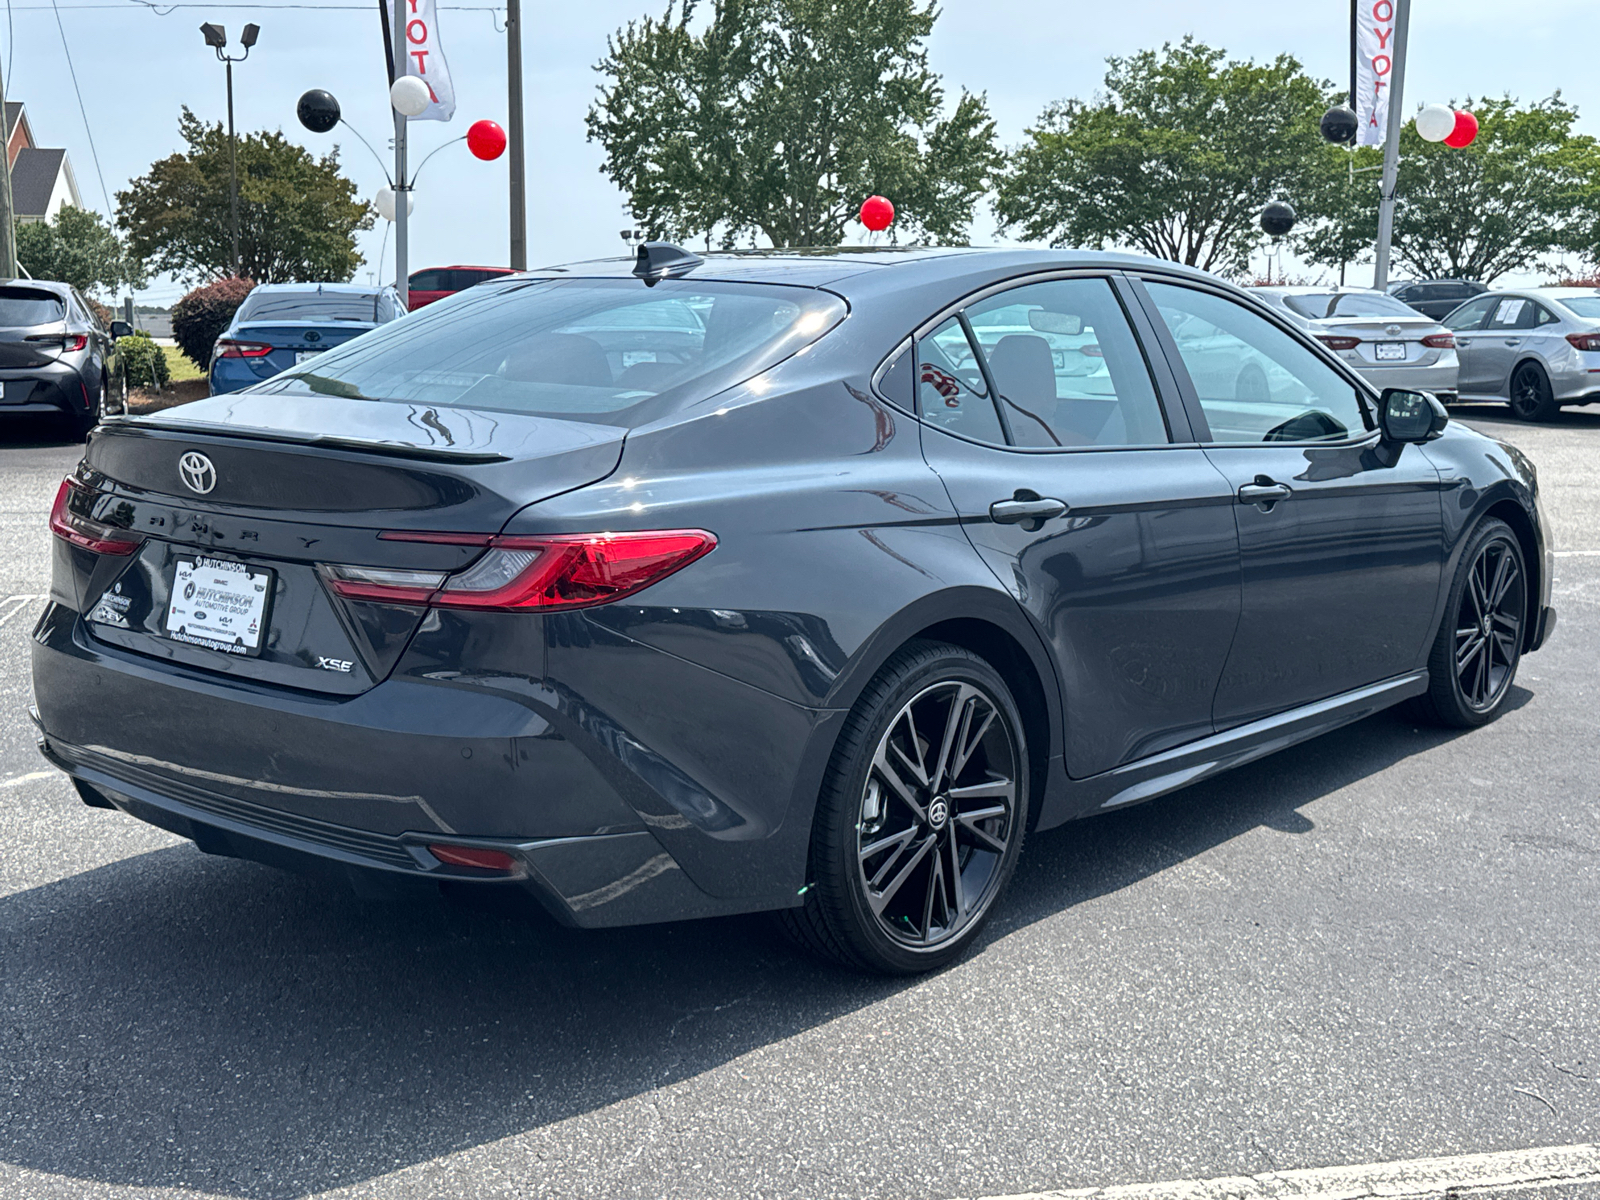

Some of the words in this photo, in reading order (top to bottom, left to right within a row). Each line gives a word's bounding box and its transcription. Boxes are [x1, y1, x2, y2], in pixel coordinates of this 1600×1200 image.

[406, 0, 440, 104] YOT
[202, 557, 247, 574] HUTCHINSON
[195, 587, 255, 608] HUTCHINSON
[194, 600, 229, 613] AUTOMOTIVE
[229, 606, 249, 616] GROUP
[314, 655, 354, 673] XSE
